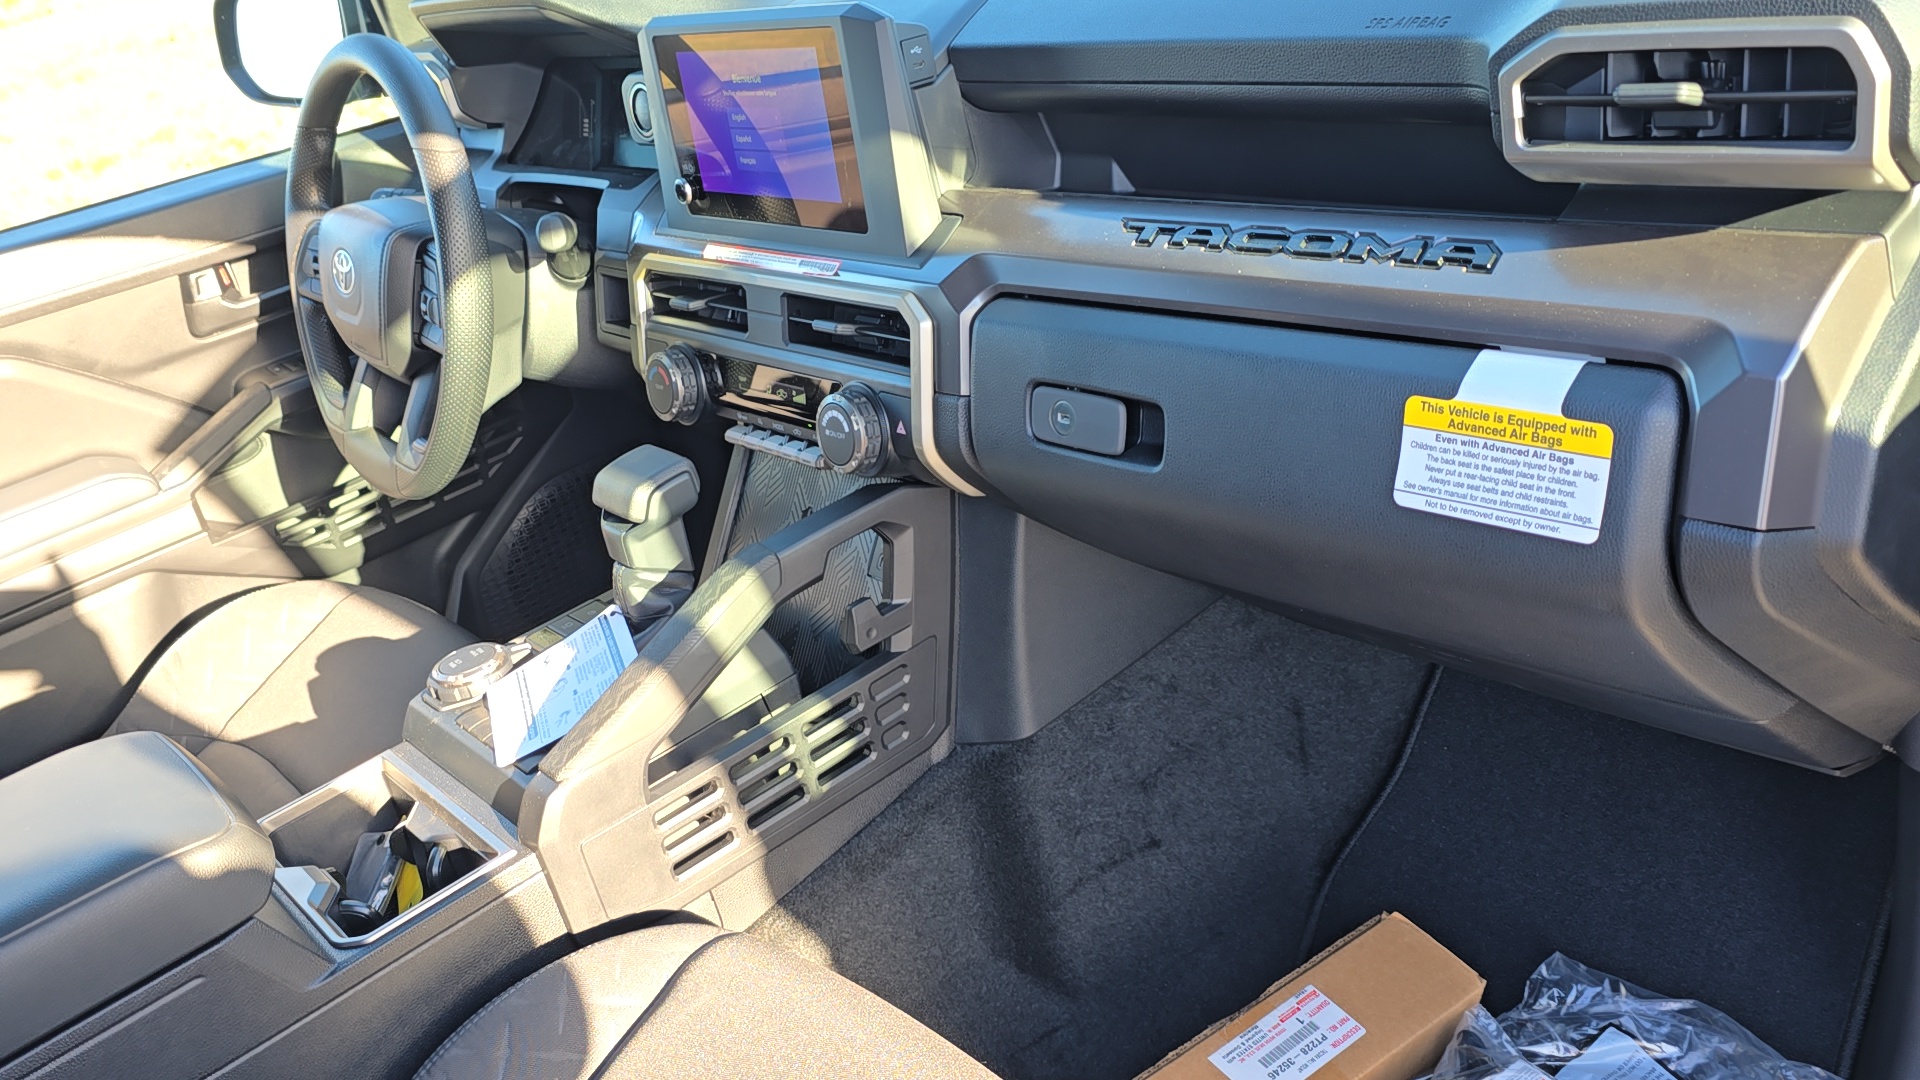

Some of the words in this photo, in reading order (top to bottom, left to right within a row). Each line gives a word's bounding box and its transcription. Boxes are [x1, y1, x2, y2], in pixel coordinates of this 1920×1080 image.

[1392, 16, 1452, 28] AIRBAG
[732, 114, 746, 122] English
[1121, 217, 1503, 275] TACOMA
[1420, 401, 1444, 414] This
[1447, 405, 1490, 421] Vehicle
[1492, 411, 1504, 423] is
[1507, 414, 1567, 435] Equipped
[1570, 423, 1597, 438] with
[1447, 418, 1506, 437] Advanced
[1509, 428, 1528, 440] Air
[1530, 431, 1563, 448] Bags
[1410, 440, 1437, 452] Children
[1452, 448, 1460, 456] be
[1462, 449, 1480, 459] killed
[1489, 454, 1521, 467] seriously
[1522, 459, 1546, 472] injured
[1547, 464, 1558, 473] by
[1558, 466, 1570, 475] the
[1571, 468, 1582, 477] air
[1583, 470, 1601, 482] bag.
[1434, 433, 1457, 444] Even
[1459, 437, 1479, 448] with
[1481, 441, 1529, 456] Advanced
[1531, 449, 1546, 459] Air
[1548, 452, 1574, 466] Bags
[1424, 463, 1444, 473] Never
[1444, 467, 1456, 477] put
[1463, 471, 1499, 485] rear-facing
[1500, 477, 1518, 487] child
[1519, 481, 1535, 490] seat
[1536, 483, 1543, 492] in
[1544, 485, 1556, 494] the
[1557, 488, 1577, 498] front.
[1426, 453, 1439, 462] The
[1440, 456, 1456, 465] back
[1457, 459, 1472, 468] seat
[1480, 463, 1492, 472] the
[1493, 465, 1514, 476] safest
[1515, 469, 1535, 480] place
[1536, 473, 1546, 481] for
[1547, 475, 1578, 487] children.
[1403, 480, 1416, 489] See
[1417, 483, 1442, 494] owner's
[1443, 488, 1468, 499] manual
[1469, 493, 1478, 501] for
[1479, 496, 1497, 505] more
[1499, 498, 1538, 513] information
[1539, 506, 1560, 517] about
[1561, 510, 1571, 520] air
[1572, 513, 1594, 526] bags.
[1427, 474, 1451, 486] Always
[1452, 480, 1464, 488] use
[1465, 482, 1480, 491] seat
[1481, 485, 1499, 494] belts
[1500, 488, 1514, 497] and
[1514, 491, 1532, 501] child
[1533, 494, 1569, 508] restraints.
[1424, 499, 1438, 508] Not
[1439, 502, 1446, 510] to
[1448, 504, 1458, 512] be
[1459, 506, 1493, 519] removed
[1494, 513, 1520, 526] except
[1522, 519, 1532, 528] by
[1534, 523, 1561, 533] owner.
[1304, 998, 1330, 1018] QUANTITY:
[1335, 1015, 1350, 1026] PART
[1235, 1043, 1253, 1057] STATES
[1251, 1032, 1268, 1045] UNITED
[1328, 1024, 1361, 1049] DESCRIPTION:
